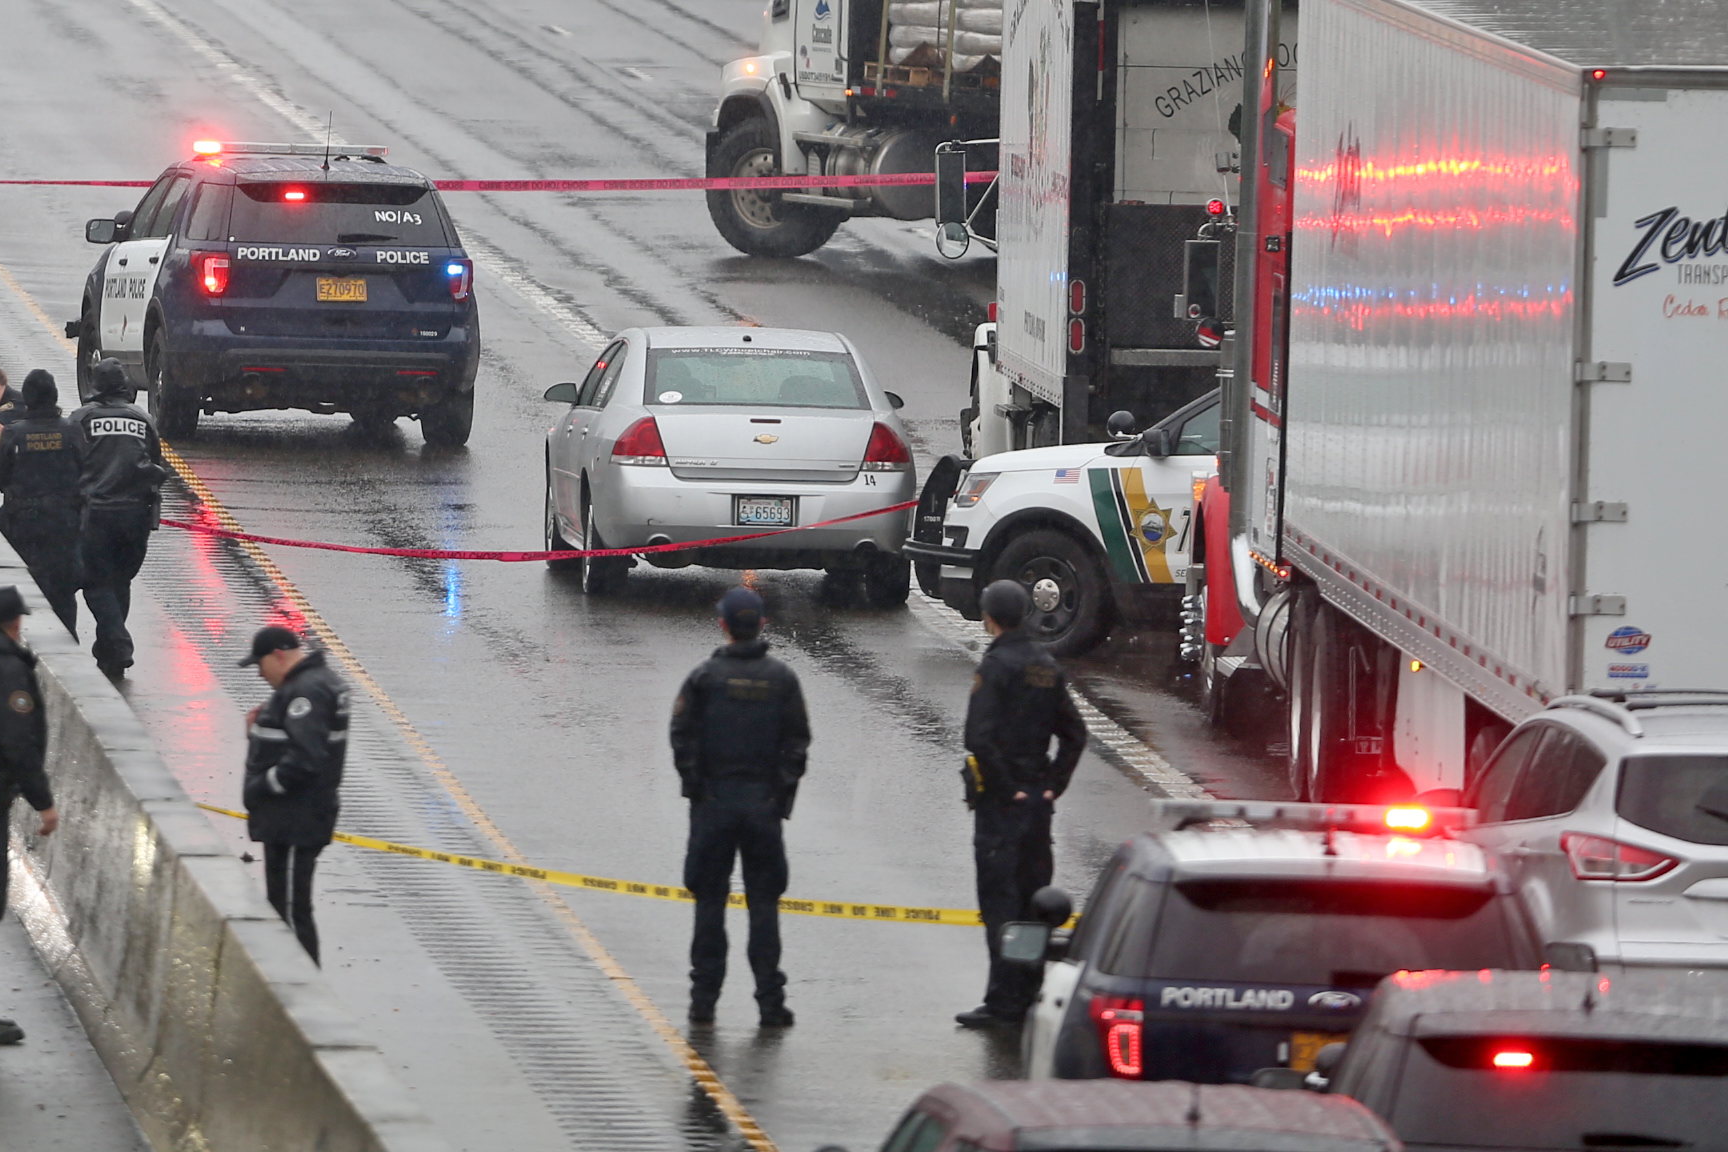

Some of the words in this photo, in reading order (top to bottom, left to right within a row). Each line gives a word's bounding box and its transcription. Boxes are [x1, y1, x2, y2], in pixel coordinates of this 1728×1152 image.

[237, 247, 321, 262] PORTLAND
[376, 250, 430, 264] POLICE
[105, 278, 127, 299] PORTLAND
[129, 278, 146, 299] POLICE
[319, 283, 365, 296] E270970
[93, 420, 145, 436] POLICE
[26, 433, 62, 441] PORTLAND
[27, 441, 62, 450] POLICE
[864, 474, 876, 486] 14
[755, 506, 790, 520] 65693
[1608, 636, 1649, 647] UTILITY
[822, 903, 844, 915] NOT
[852, 905, 866, 916] DO
[874, 906, 897, 918] LINE
[904, 908, 940, 920] POLICE
[1160, 986, 1295, 1010] PORTLAND
